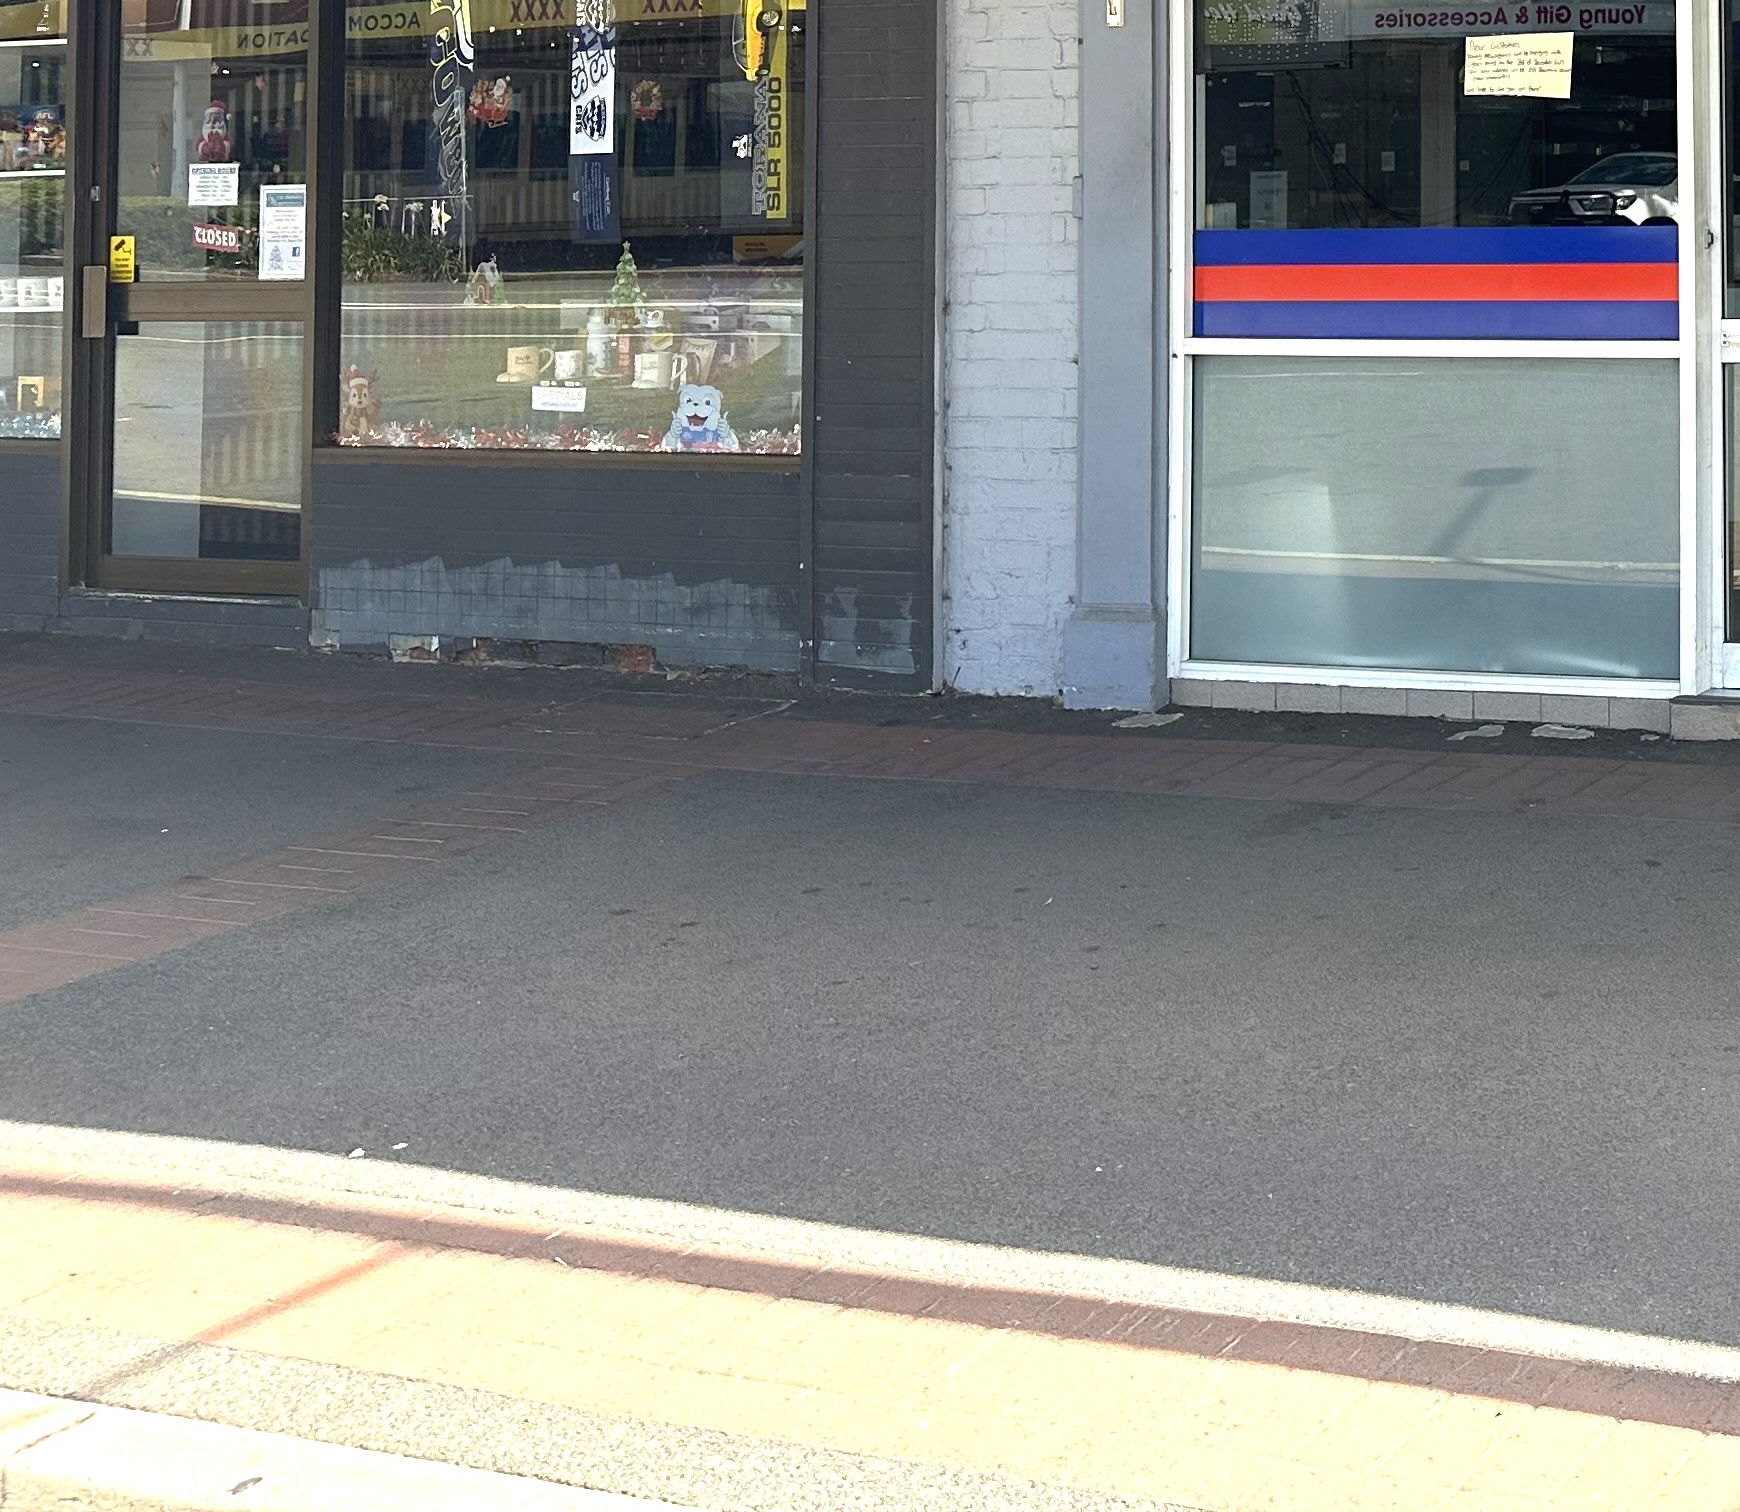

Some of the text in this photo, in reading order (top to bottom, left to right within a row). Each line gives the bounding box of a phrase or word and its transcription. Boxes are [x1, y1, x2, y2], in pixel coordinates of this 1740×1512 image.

[767, 76, 782, 212] SLR 5000
[195, 227, 236, 247] CLOSED
